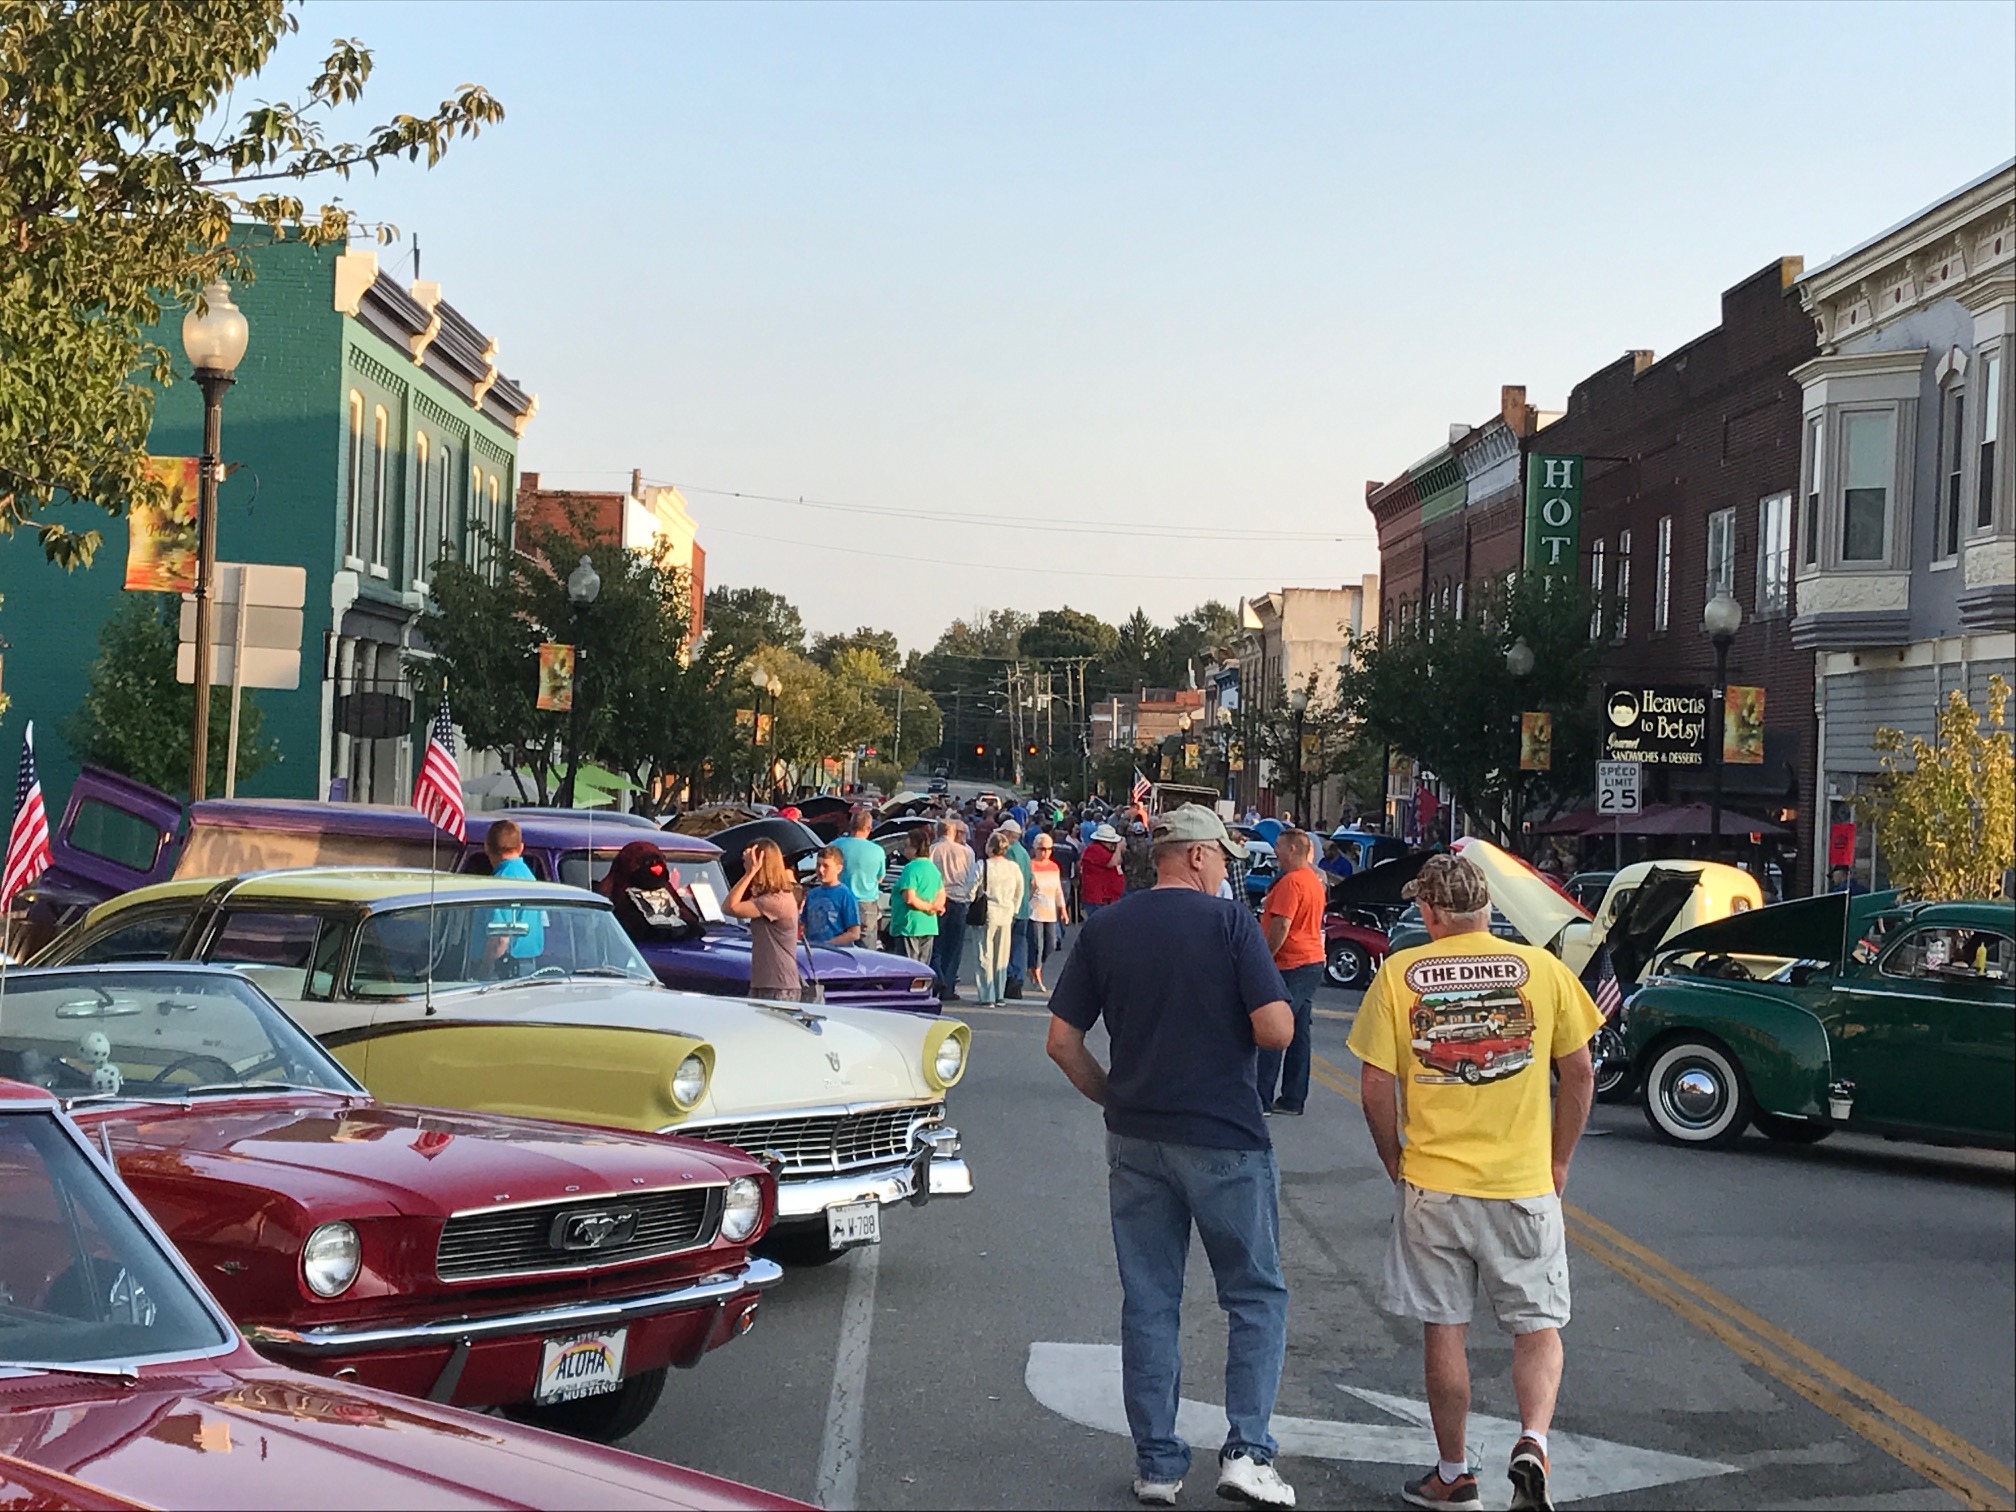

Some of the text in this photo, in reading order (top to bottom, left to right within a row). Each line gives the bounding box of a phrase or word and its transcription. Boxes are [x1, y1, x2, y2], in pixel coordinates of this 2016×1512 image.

[1642, 690, 1706, 714] Heavens
[1641, 715, 1705, 747] to Betsy!
[1611, 750, 1702, 764] SANDWICHES & DESSERTS
[1600, 766, 1637, 776] SPEED
[1604, 778, 1634, 787] LIMIT
[1601, 789, 1637, 809] 25
[1420, 964, 1517, 983] THE DINER
[556, 1346, 606, 1380] ALOHA
[563, 1383, 617, 1402] MUSTANG
